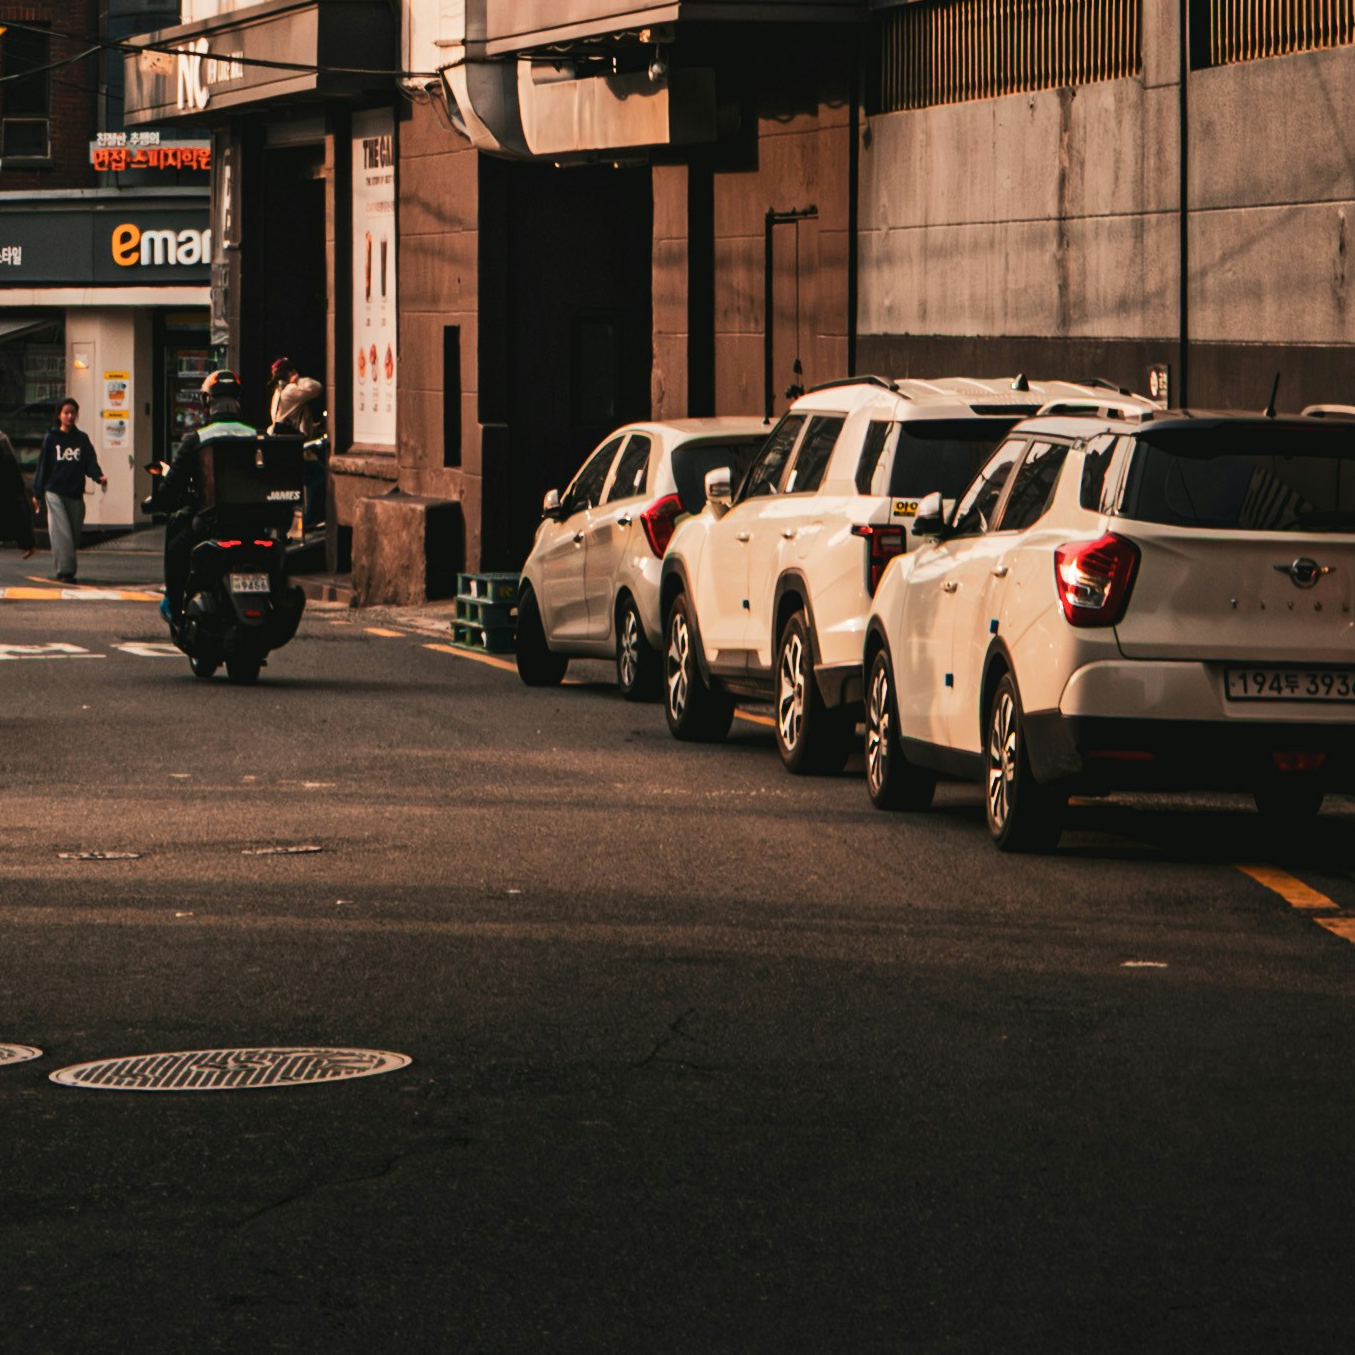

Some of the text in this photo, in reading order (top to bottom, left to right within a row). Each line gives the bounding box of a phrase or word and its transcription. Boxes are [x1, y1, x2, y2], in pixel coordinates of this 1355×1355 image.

[176, 37, 210, 110] NC
[55, 444, 81, 461] Lee
[266, 489, 301, 501] JAMES
[1305, 673, 1355, 696] 393
